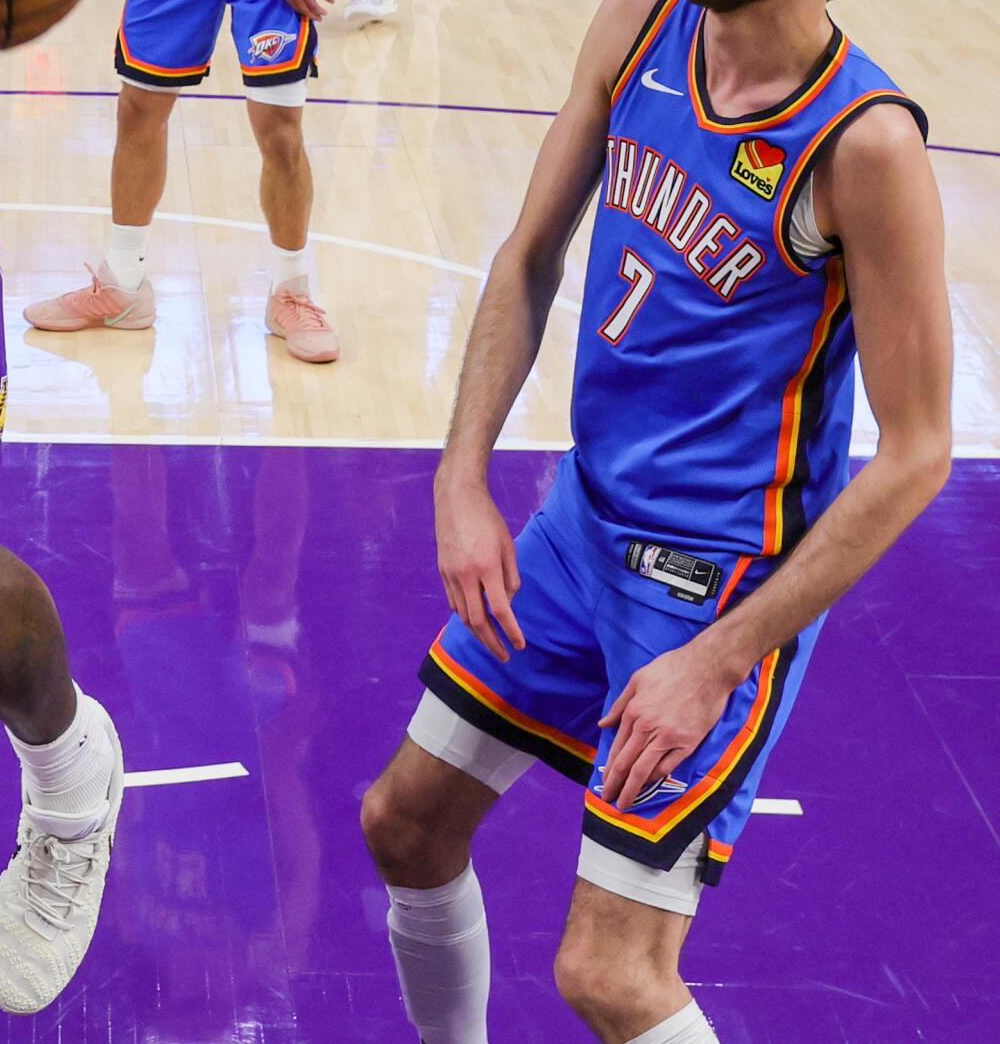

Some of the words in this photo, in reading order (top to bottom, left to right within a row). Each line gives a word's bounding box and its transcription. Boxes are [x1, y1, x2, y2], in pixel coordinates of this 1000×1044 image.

[254, 36, 281, 56] OKC
[605, 134, 766, 302] THUNDER
[597, 246, 656, 346] 7
